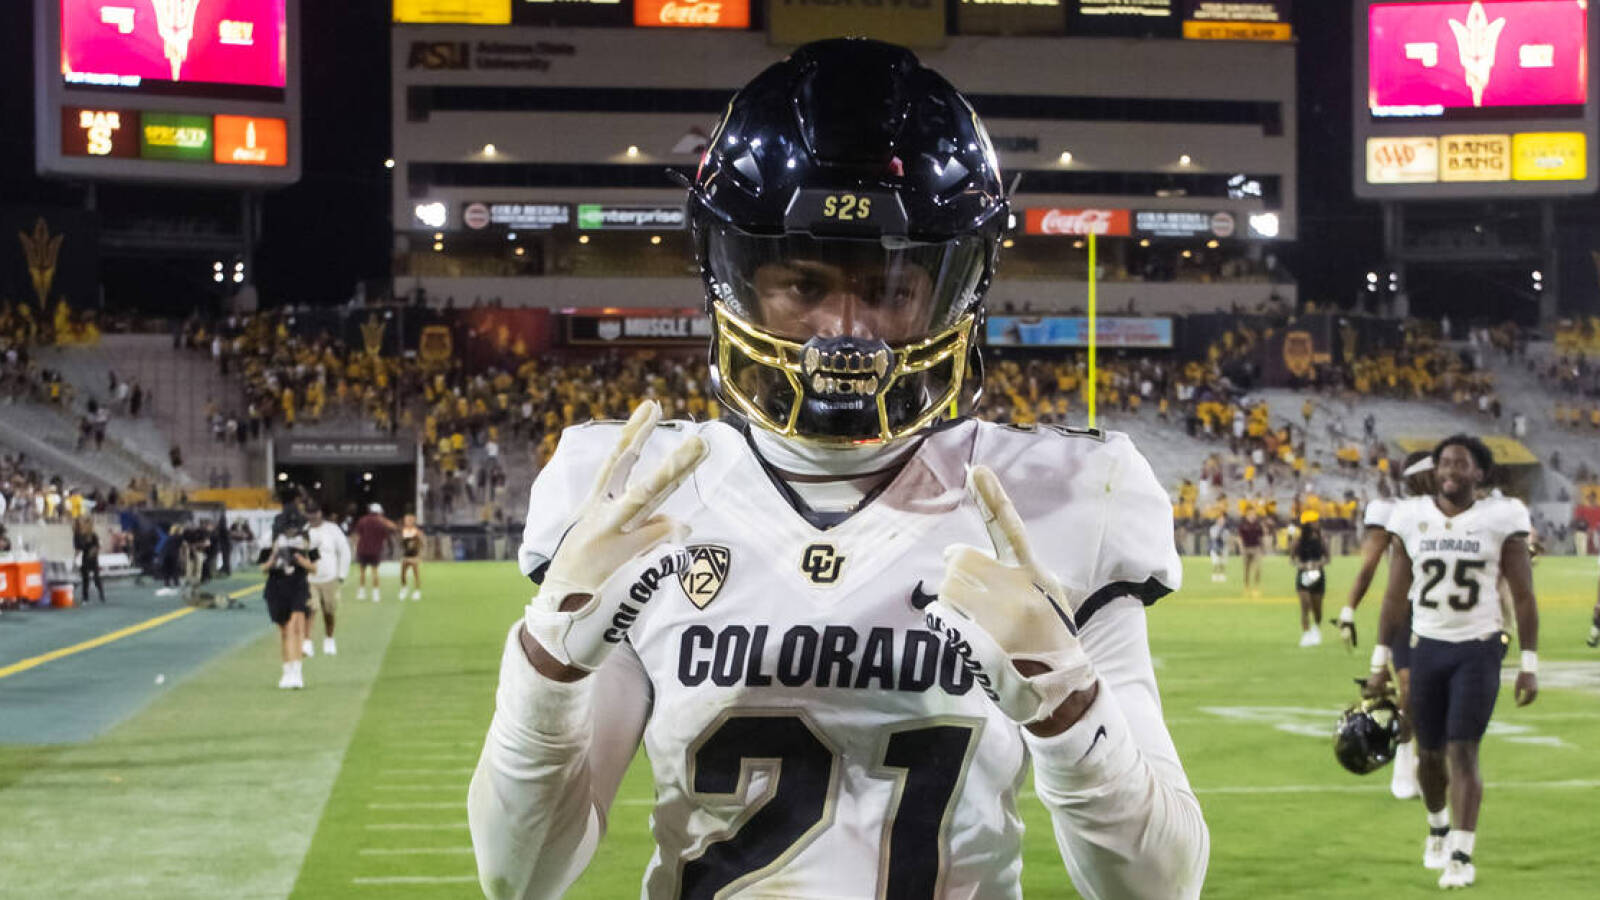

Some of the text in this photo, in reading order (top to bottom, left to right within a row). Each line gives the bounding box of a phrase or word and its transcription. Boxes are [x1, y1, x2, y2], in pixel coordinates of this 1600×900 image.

[407, 42, 470, 69] ASU
[1449, 141, 1503, 153] BANG
[1449, 156, 1503, 169] BANG
[582, 209, 683, 225] enterprise
[1040, 209, 1112, 235] Coca-Cola
[624, 317, 689, 336] MUSCLE
[1419, 538, 1481, 553] COLORADO
[802, 543, 845, 583] CU
[1419, 558, 1486, 611] 25
[678, 624, 975, 697] COLORADO
[680, 707, 988, 900] 21
